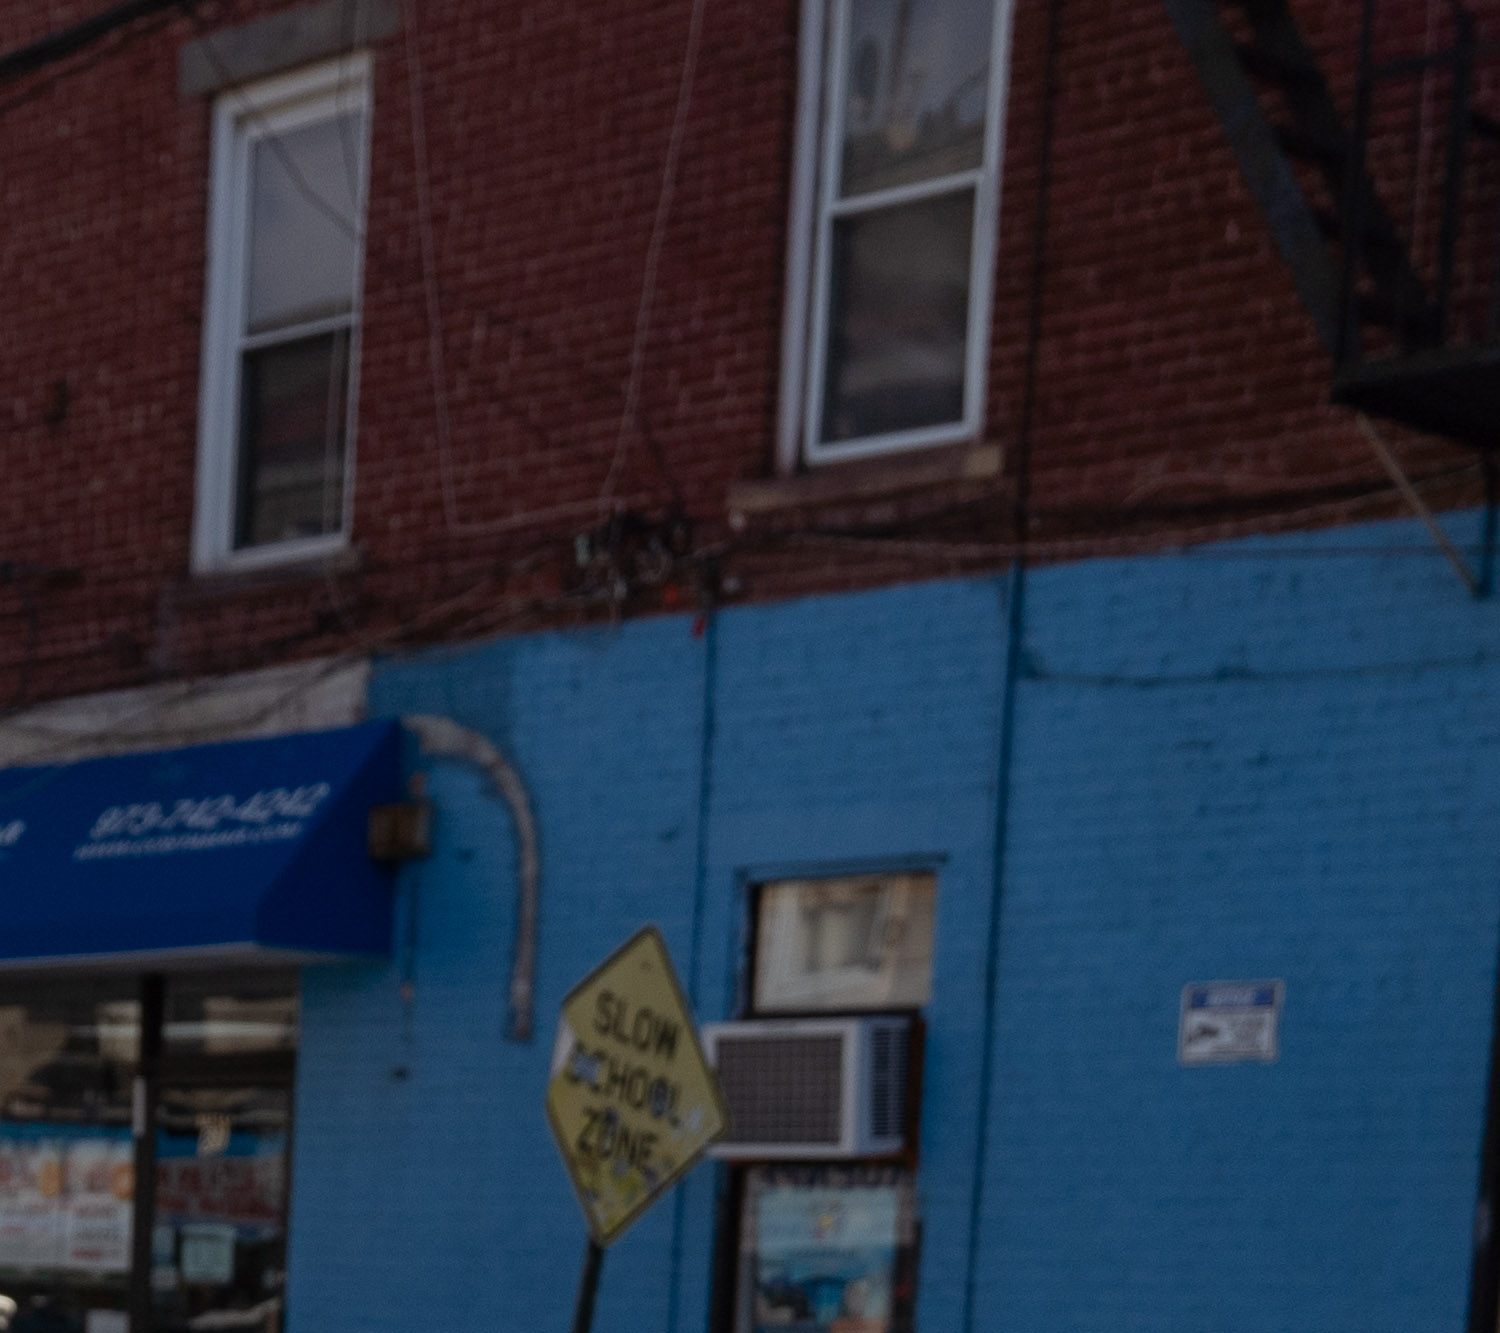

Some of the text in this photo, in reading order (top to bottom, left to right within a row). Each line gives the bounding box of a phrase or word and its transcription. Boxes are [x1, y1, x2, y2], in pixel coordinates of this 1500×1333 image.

[89, 781, 331, 840] 973-742-4242
[594, 989, 680, 1061] SLOW
[577, 1106, 659, 1168] ZONE
